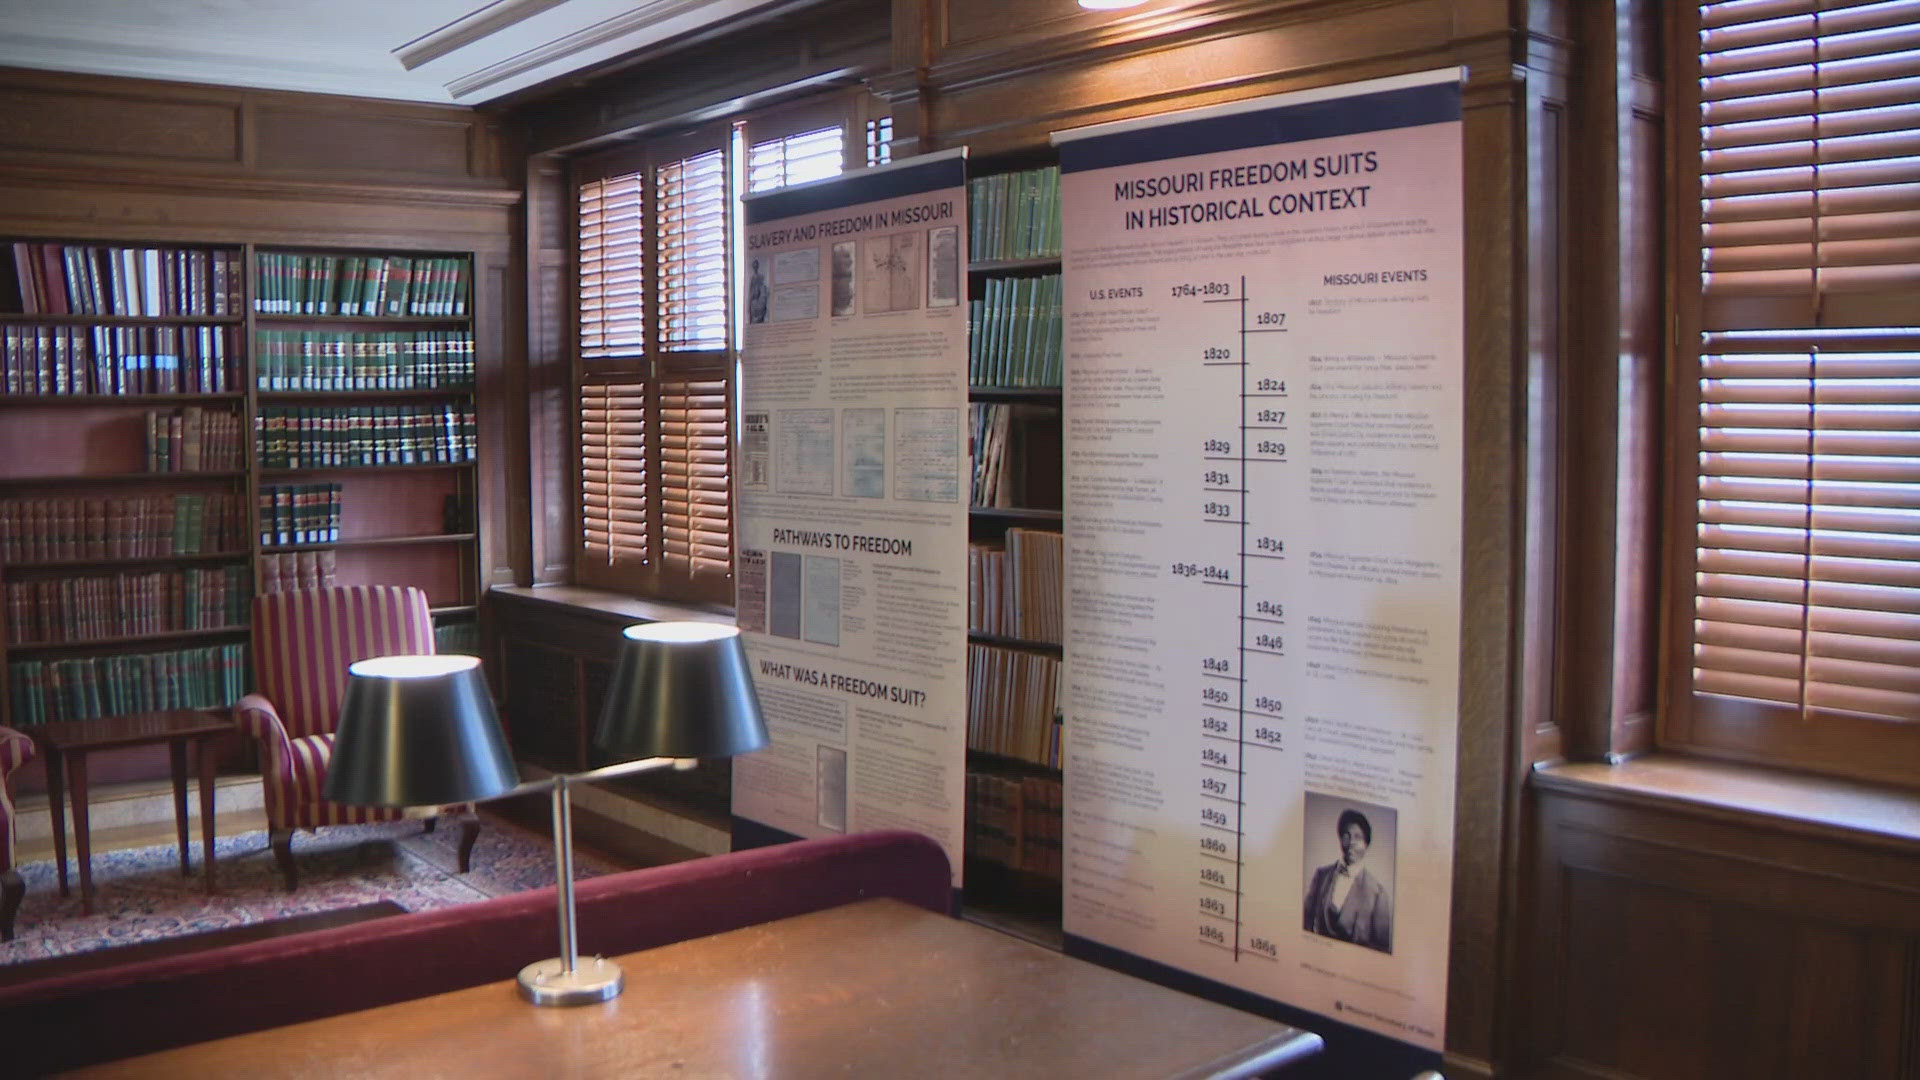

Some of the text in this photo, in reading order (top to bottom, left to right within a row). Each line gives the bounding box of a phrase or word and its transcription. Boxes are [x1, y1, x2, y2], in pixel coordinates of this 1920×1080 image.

[1114, 151, 1378, 201] MISSOURI FREEDOM SUITS
[1125, 186, 1371, 230] IN HISTORICAL CONTEXT
[748, 201, 953, 250] SLAVERY AND FREEDOM IN MISSOURI
[1323, 269, 1427, 286] MISSOURI EVENTS
[1108, 287, 1143, 299] EVENTS
[1257, 313, 1286, 326] 1807
[1204, 347, 1230, 360] 1820
[1257, 378, 1285, 392] 1824
[1257, 410, 1285, 423] 1827
[1204, 439, 1230, 452] 1829
[1257, 441, 1285, 455] 1829
[1204, 471, 1230, 484] 1831
[1204, 502, 1230, 516] 1833
[773, 528, 912, 556] PATHWAYS TO FREEDOM
[1257, 537, 1283, 551] 1834
[1256, 601, 1283, 616] 1845
[1256, 635, 1283, 649] 1846
[1202, 658, 1229, 672] 1848
[760, 659, 790, 680] WHAT
[793, 668, 818, 685] WAS
[820, 672, 828, 688] A
[830, 674, 888, 700] FREEDOM
[890, 686, 926, 708] SUIT?
[1202, 688, 1228, 702] 1850
[1256, 697, 1282, 712] 1850
[1202, 717, 1228, 732] 1852
[1255, 728, 1282, 742] 1852
[1202, 749, 1228, 765] 1854
[1202, 778, 1227, 794] 1857
[1201, 808, 1227, 825] 1859
